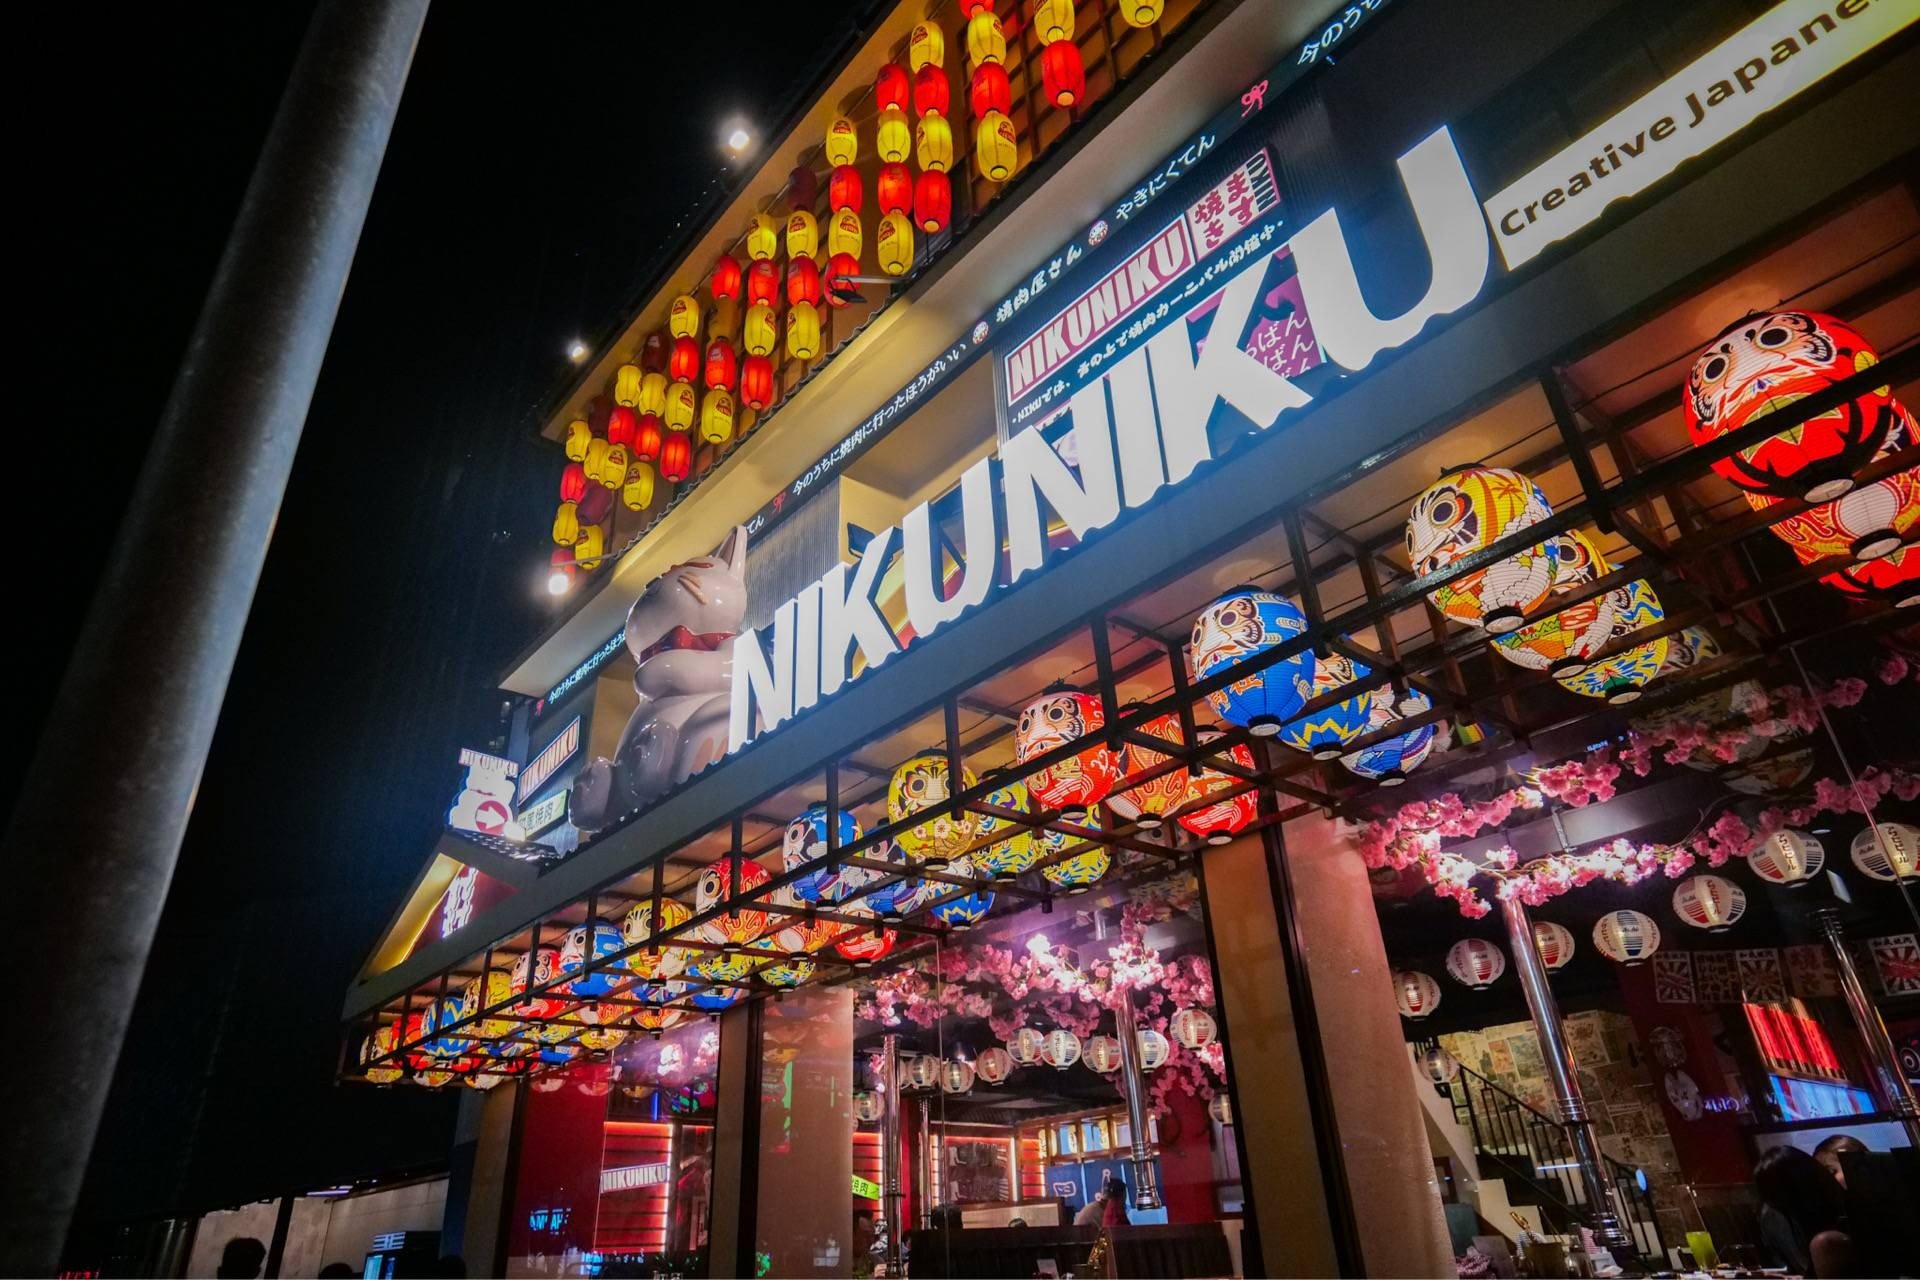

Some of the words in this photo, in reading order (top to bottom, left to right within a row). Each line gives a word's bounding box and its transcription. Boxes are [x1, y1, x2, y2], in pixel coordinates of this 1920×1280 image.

[1499, 115, 1678, 237] Creative
[1688, 0, 1882, 128] Japane
[1115, 134, 1216, 222] やきにくてん
[1194, 190, 1225, 249] 焼き
[1227, 170, 1255, 226] ます
[995, 245, 1082, 325] 焼肉屋さん
[1009, 224, 1185, 396] NIKUNIKU
[729, 125, 1491, 754] NIKUNIKU
[602, 1164, 667, 1191] NIKUNIKU
